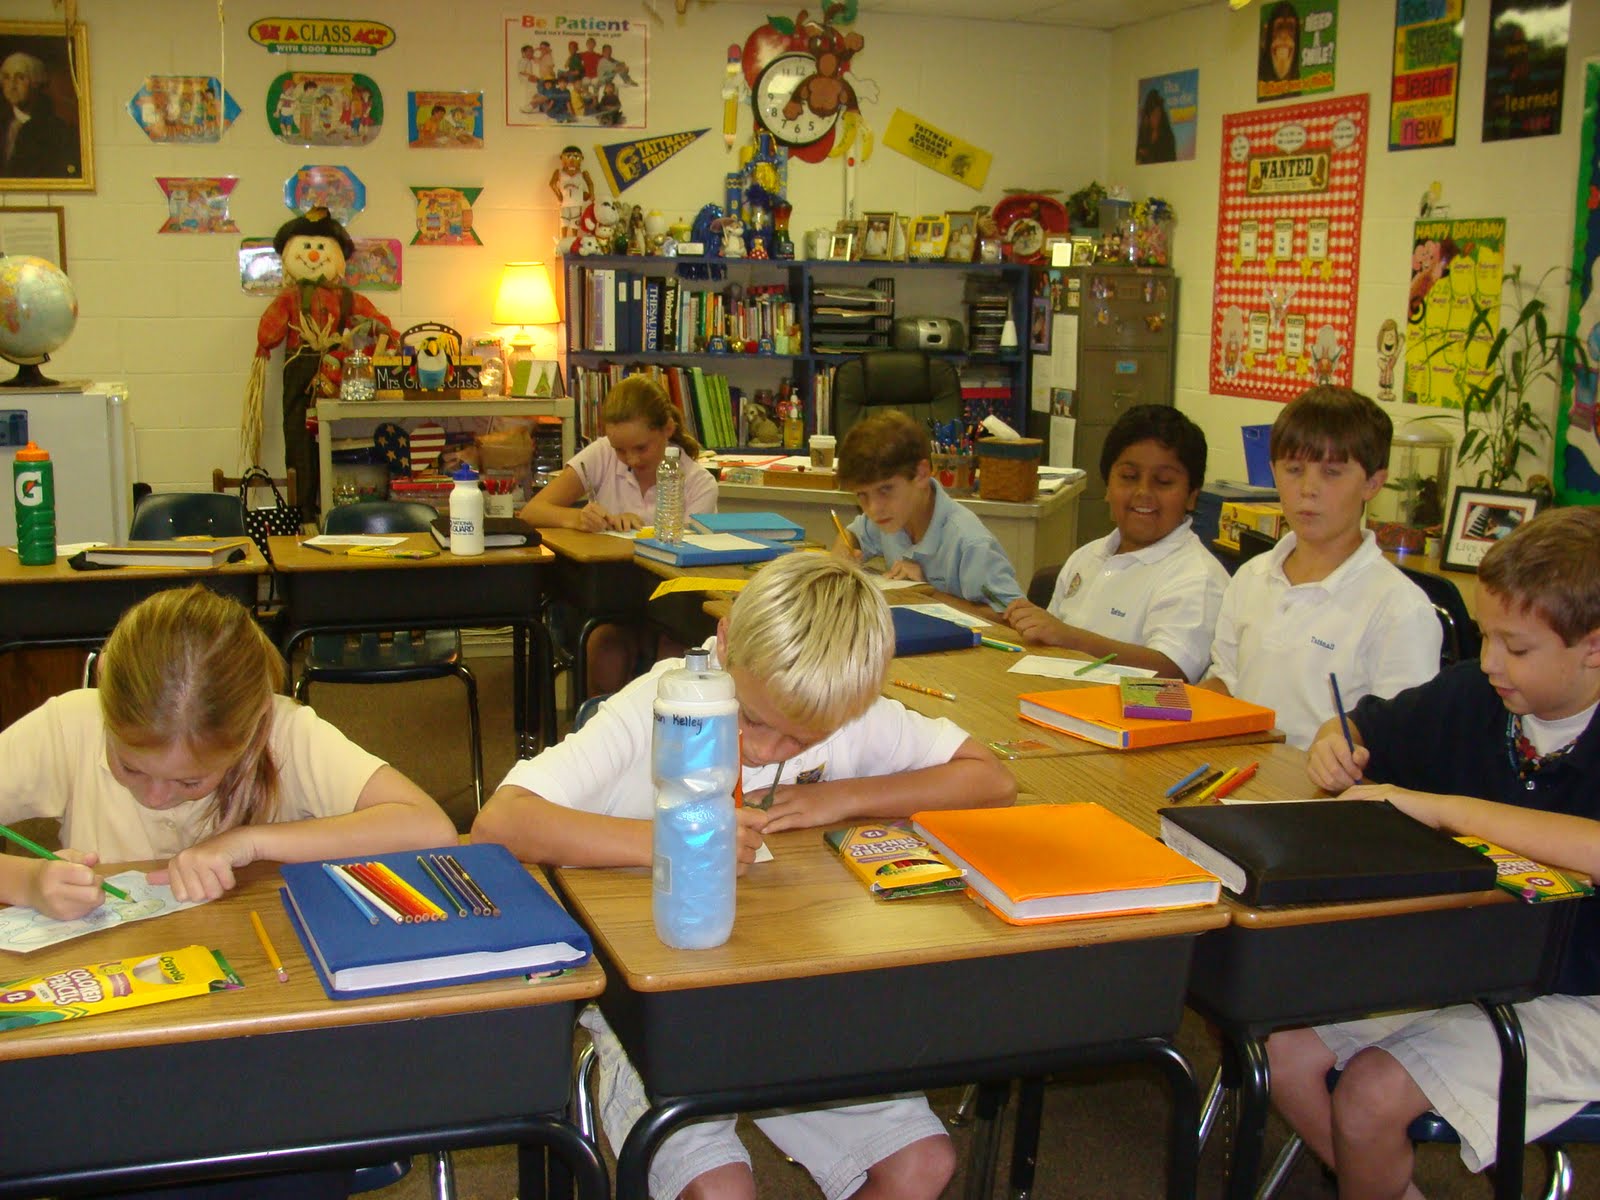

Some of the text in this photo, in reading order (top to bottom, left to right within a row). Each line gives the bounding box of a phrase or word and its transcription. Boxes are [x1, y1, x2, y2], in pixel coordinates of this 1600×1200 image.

[522, 15, 630, 31] Be Patient
[284, 25, 299, 40] A
[300, 24, 351, 42] CLASS
[352, 28, 387, 45] ACT
[276, 44, 371, 54] WITH GOOD MANNERS
[795, 66, 805, 76] 12
[1408, 69, 1452, 98] learn
[768, 93, 774, 101] 9
[1505, 90, 1559, 112] learned
[771, 107, 778, 117] 8
[781, 119, 787, 129] 7
[794, 124, 801, 133] 6
[808, 121, 815, 131] 5
[1404, 119, 1442, 141] new
[635, 132, 697, 158] TATTNALL
[914, 123, 953, 147] TATTNALL
[915, 131, 947, 151] SQUARE
[908, 136, 948, 158] ACADEMY
[1259, 157, 1314, 179] WANTED
[1415, 221, 1504, 240] HAPPY BIRTHDAY
[647, 286, 658, 350] THESAURUS
[664, 289, 675, 335] Webster's
[377, 367, 400, 389] Mrs
[448, 369, 480, 389] Class
[16, 470, 43, 506] G
[453, 525, 475, 533] GUARD
[672, 714, 703, 735] Kelley
[850, 836, 919, 852] PENCILS
[864, 830, 883, 838] 12
[852, 840, 928, 857] COLORED
[160, 956, 185, 981] Crayola
[44, 973, 82, 1005] PENCILS
[66, 968, 104, 1003] COLORED
[6, 991, 27, 1003] 12
